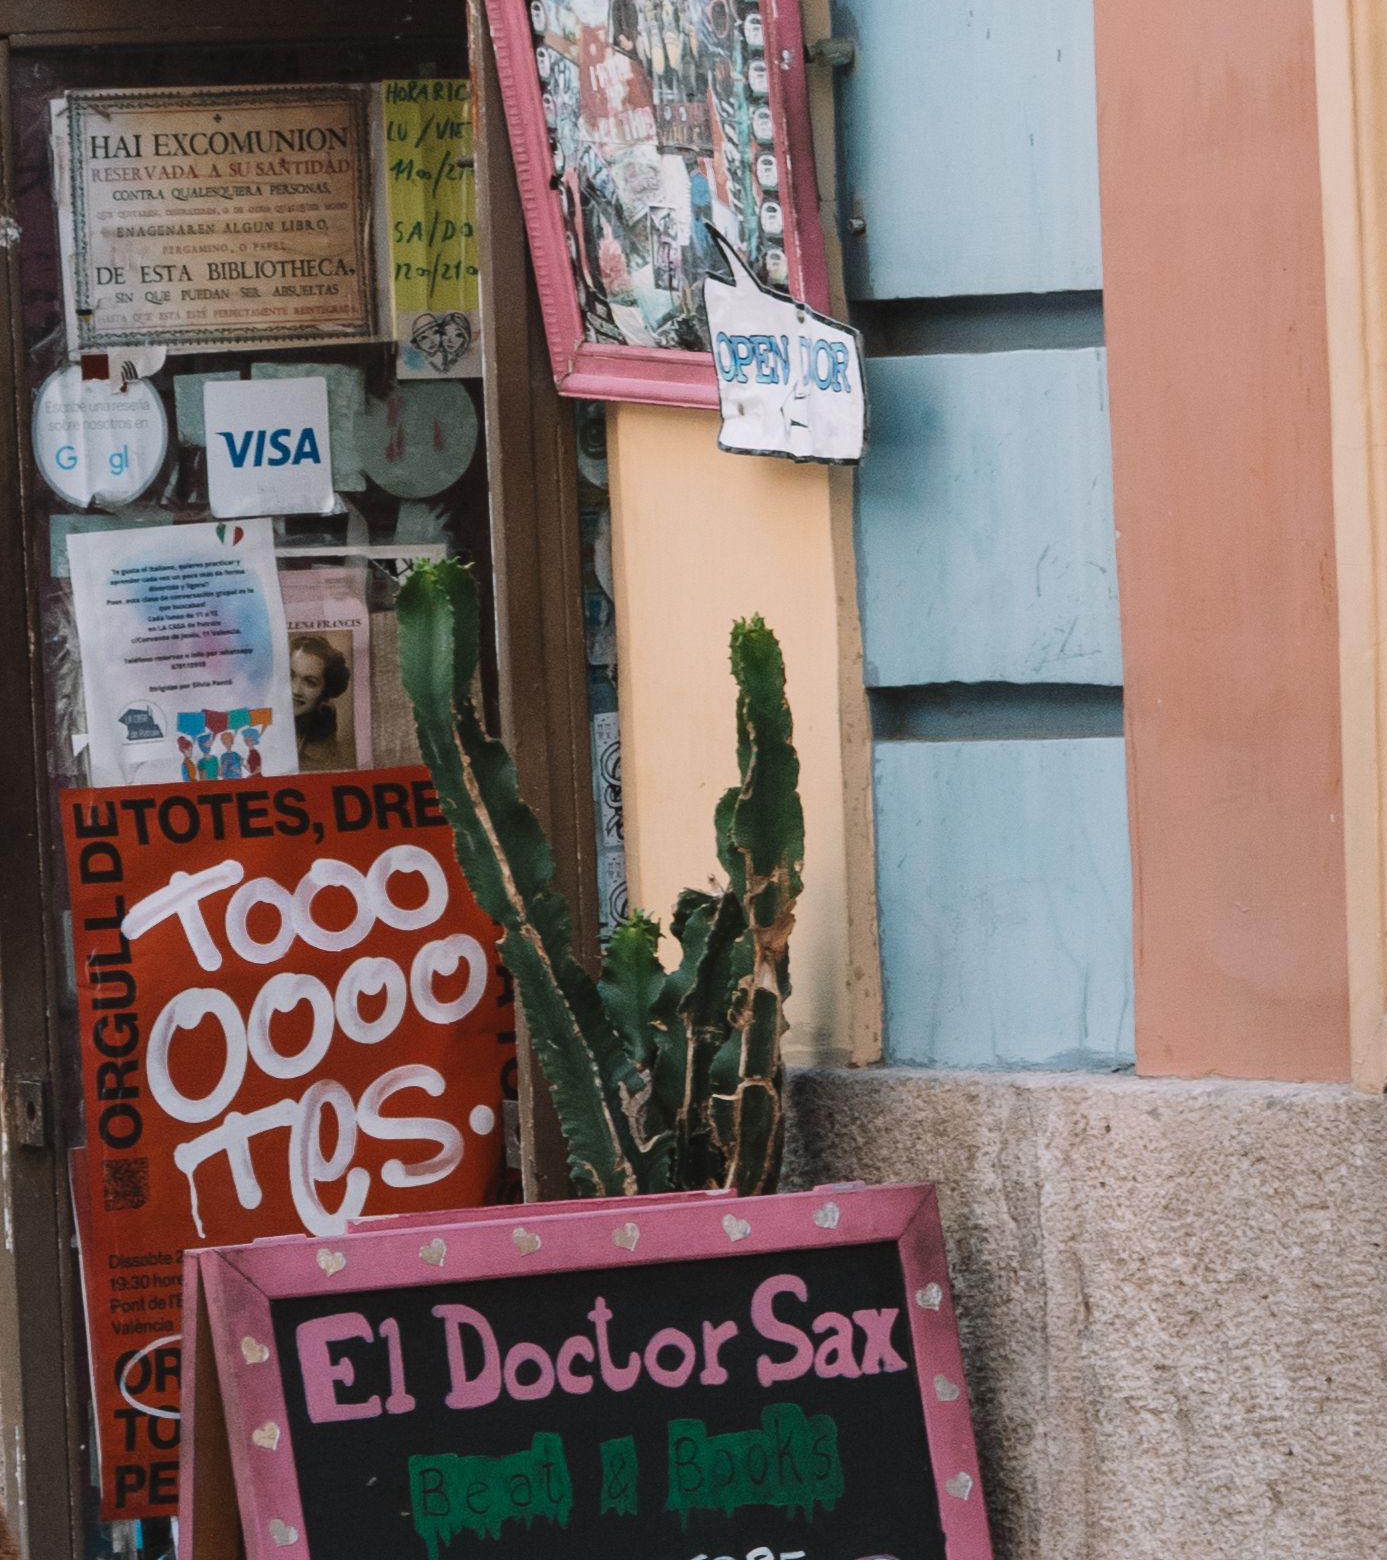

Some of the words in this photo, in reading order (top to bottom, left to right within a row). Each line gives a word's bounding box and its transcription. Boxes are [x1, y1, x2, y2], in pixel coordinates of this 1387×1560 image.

[90, 135, 142, 160] HAI
[154, 127, 348, 157] EXCOMUNION
[92, 165, 198, 183] RESERVADA
[209, 164, 222, 178] A
[230, 162, 250, 178] SU
[256, 158, 351, 176] SANTIDAD
[112, 190, 164, 201] CONTRA
[117, 223, 215, 238] ENAGENAREN
[223, 222, 273, 233] ALGUN
[97, 266, 126, 285] DE
[141, 264, 192, 284] ESTA
[207, 259, 356, 281] BIBLIOTHECA,
[115, 292, 133, 304] SIN
[145, 291, 170, 305] QUE
[181, 289, 230, 301] PUEDAN
[240, 287, 261, 298] SER
[716, 331, 790, 385] OPEN
[216, 427, 321, 468] VISA
[122, 788, 326, 845] TOTES,
[73, 801, 123, 884] DE
[84, 897, 143, 1150] ORGULL
[108, 1252, 173, 1270] Dissabte
[110, 1275, 149, 1291] 19:30
[110, 1296, 145, 1314] Pont
[147, 1294, 166, 1311] de
[295, 1311, 415, 1424] El
[432, 1295, 739, 1410] Doctor
[750, 1274, 908, 1388] Sax
[416, 1443, 567, 1520] Beat
[673, 1416, 840, 1498] Books
